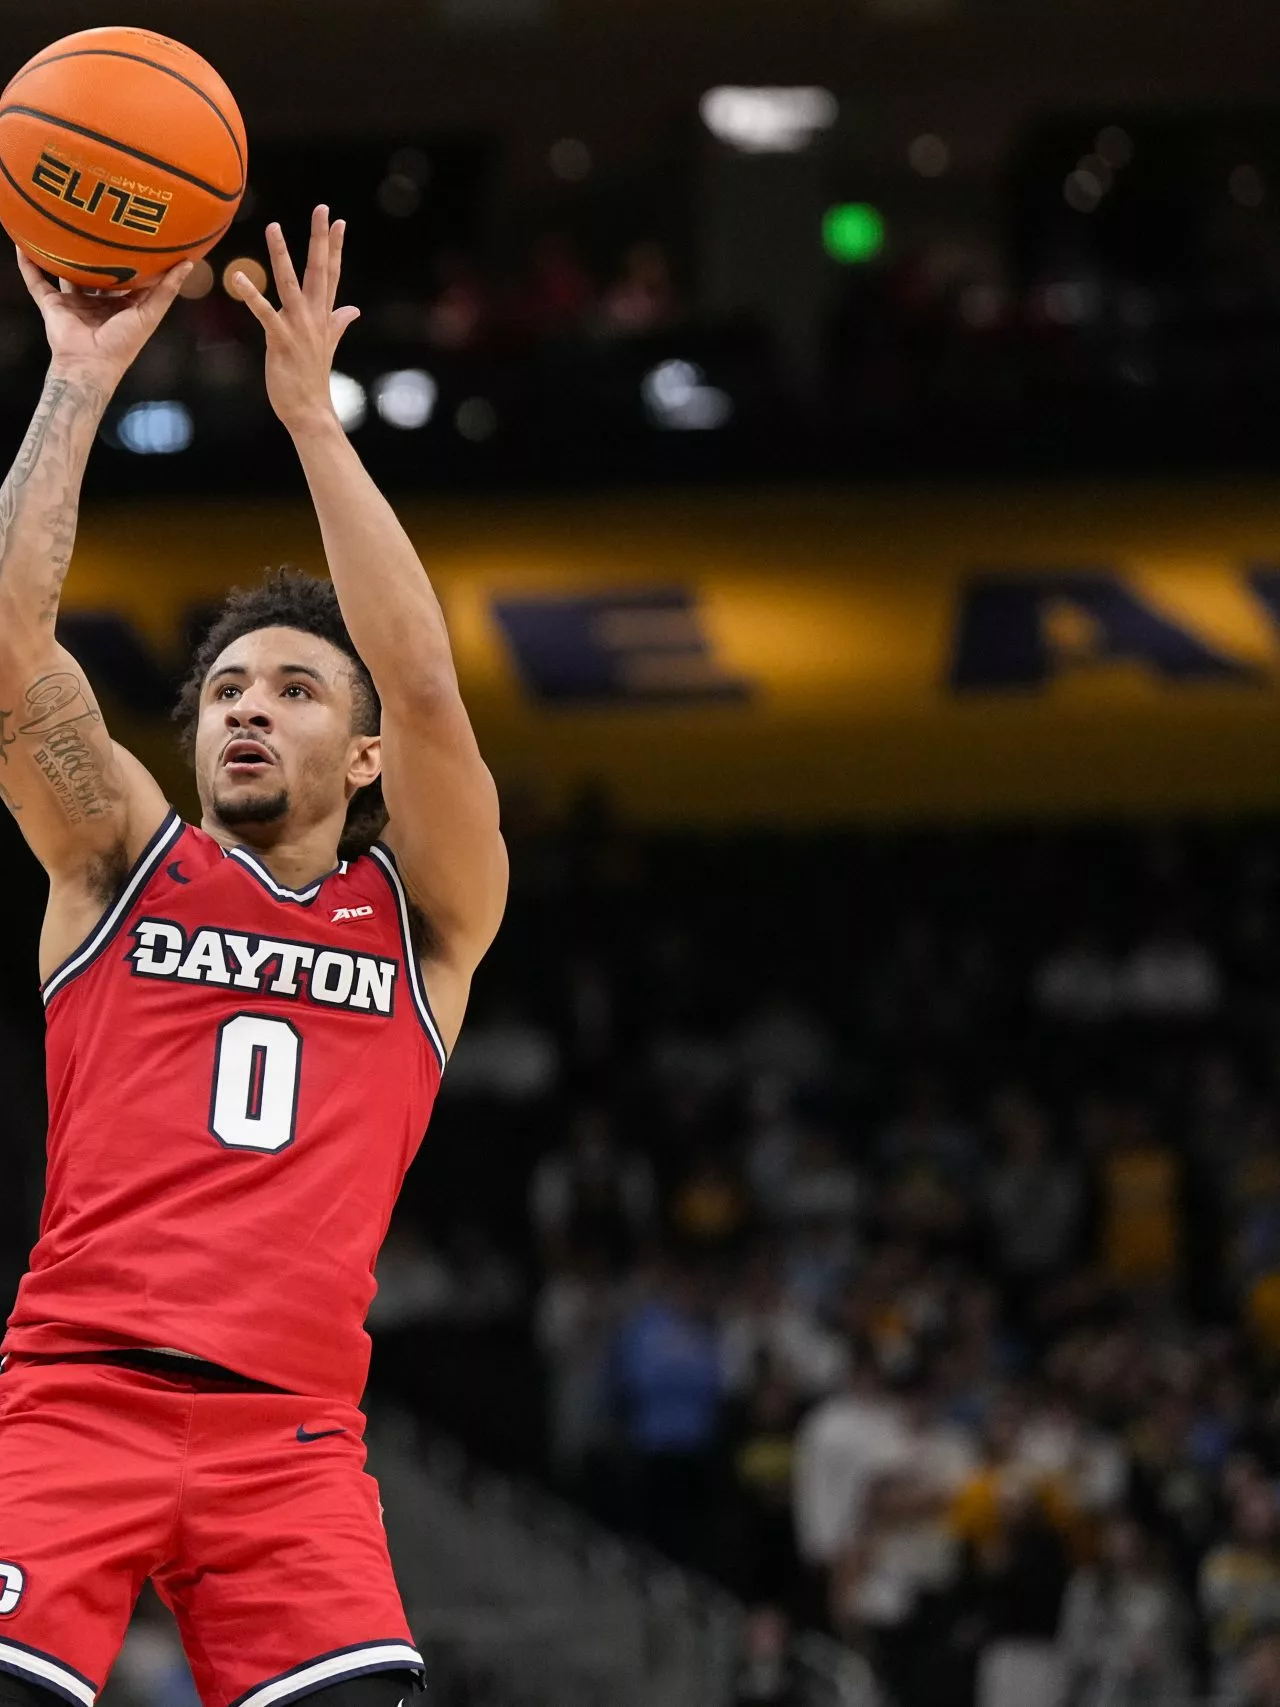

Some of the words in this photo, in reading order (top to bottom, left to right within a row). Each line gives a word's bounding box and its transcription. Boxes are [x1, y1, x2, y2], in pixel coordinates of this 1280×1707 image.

[31, 151, 169, 236] ELITE
[330, 904, 374, 923] A10
[125, 917, 398, 1016] DAYTON
[209, 1011, 303, 1154] 0
